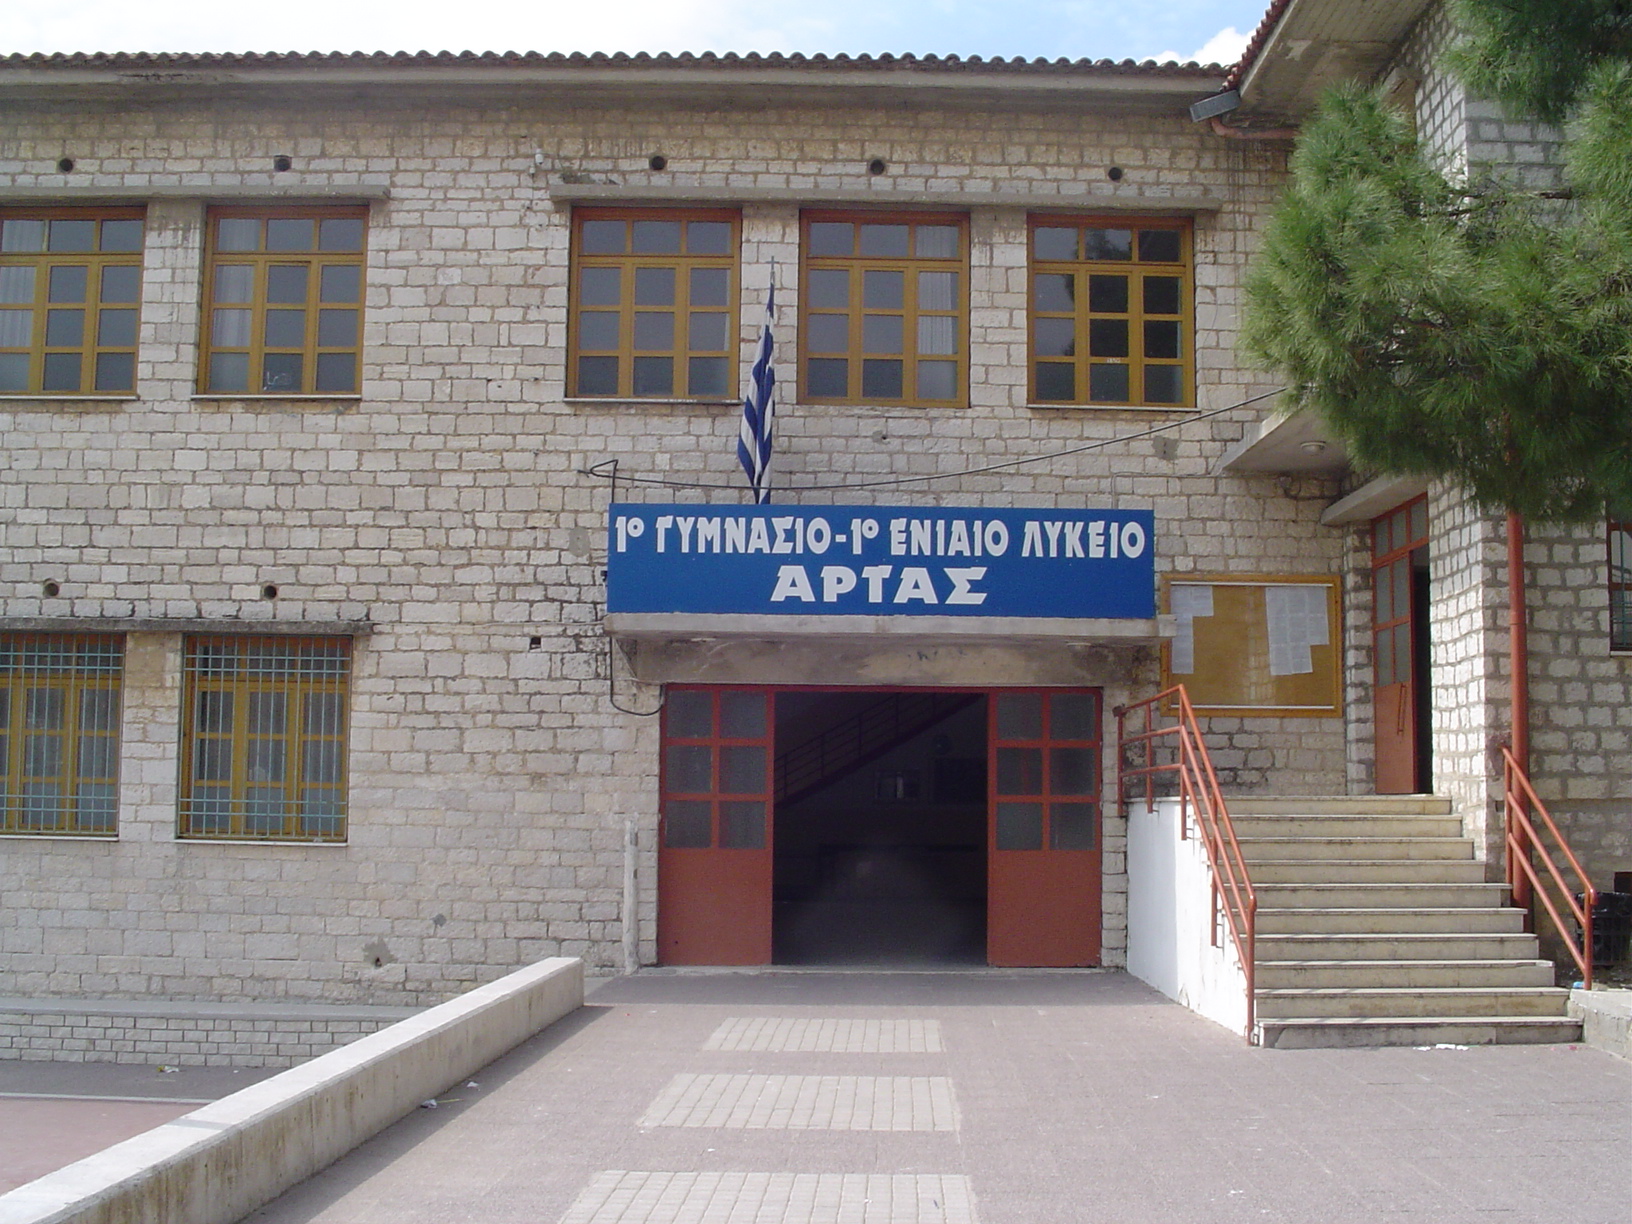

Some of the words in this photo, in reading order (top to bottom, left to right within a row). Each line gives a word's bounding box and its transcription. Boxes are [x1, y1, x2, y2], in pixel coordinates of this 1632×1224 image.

[889, 517, 1009, 557] ΕΝΙΑΙΟ
[1021, 520, 1146, 559] ΛΥΚΕΙΟ
[770, 564, 988, 605] ΑΡΤΑΣ
